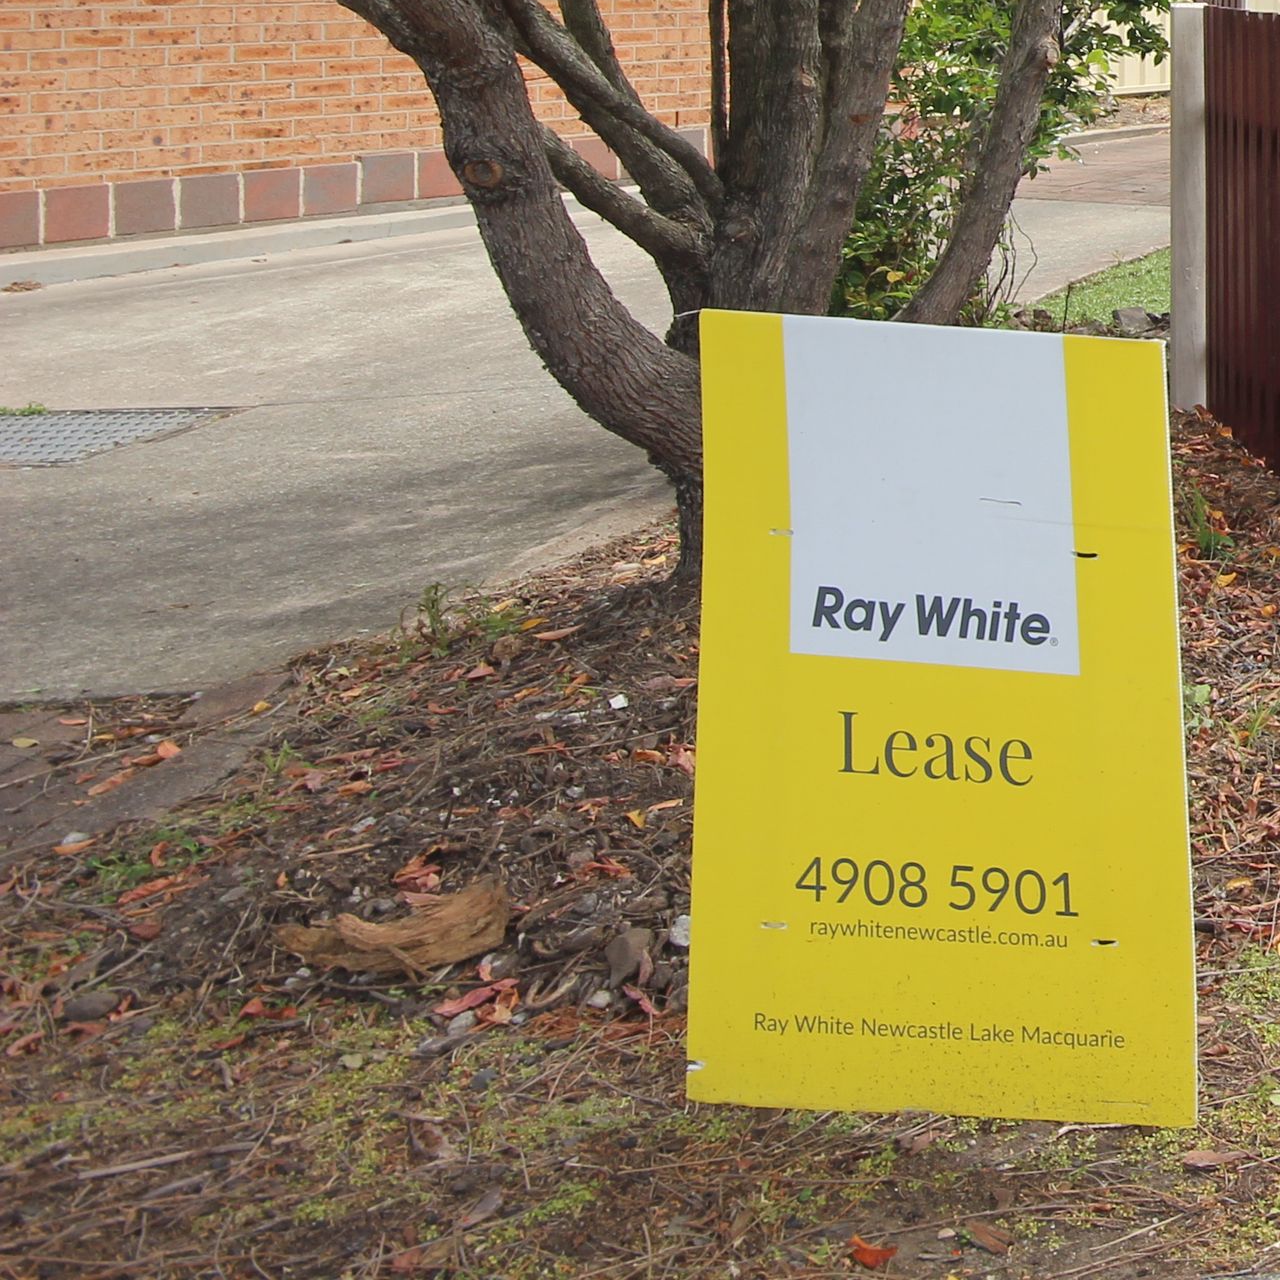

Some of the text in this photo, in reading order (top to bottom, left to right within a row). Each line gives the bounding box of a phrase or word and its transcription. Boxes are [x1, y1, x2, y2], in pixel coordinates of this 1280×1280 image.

[812, 586, 1050, 645] Ray White
[838, 711, 1033, 786] Lease
[795, 857, 1079, 917] 4908 5901
[810, 918, 1068, 948] raywhitenewcastle.com.au
[755, 1013, 1124, 1049] Ray White Newcastle Lake Macquarie
